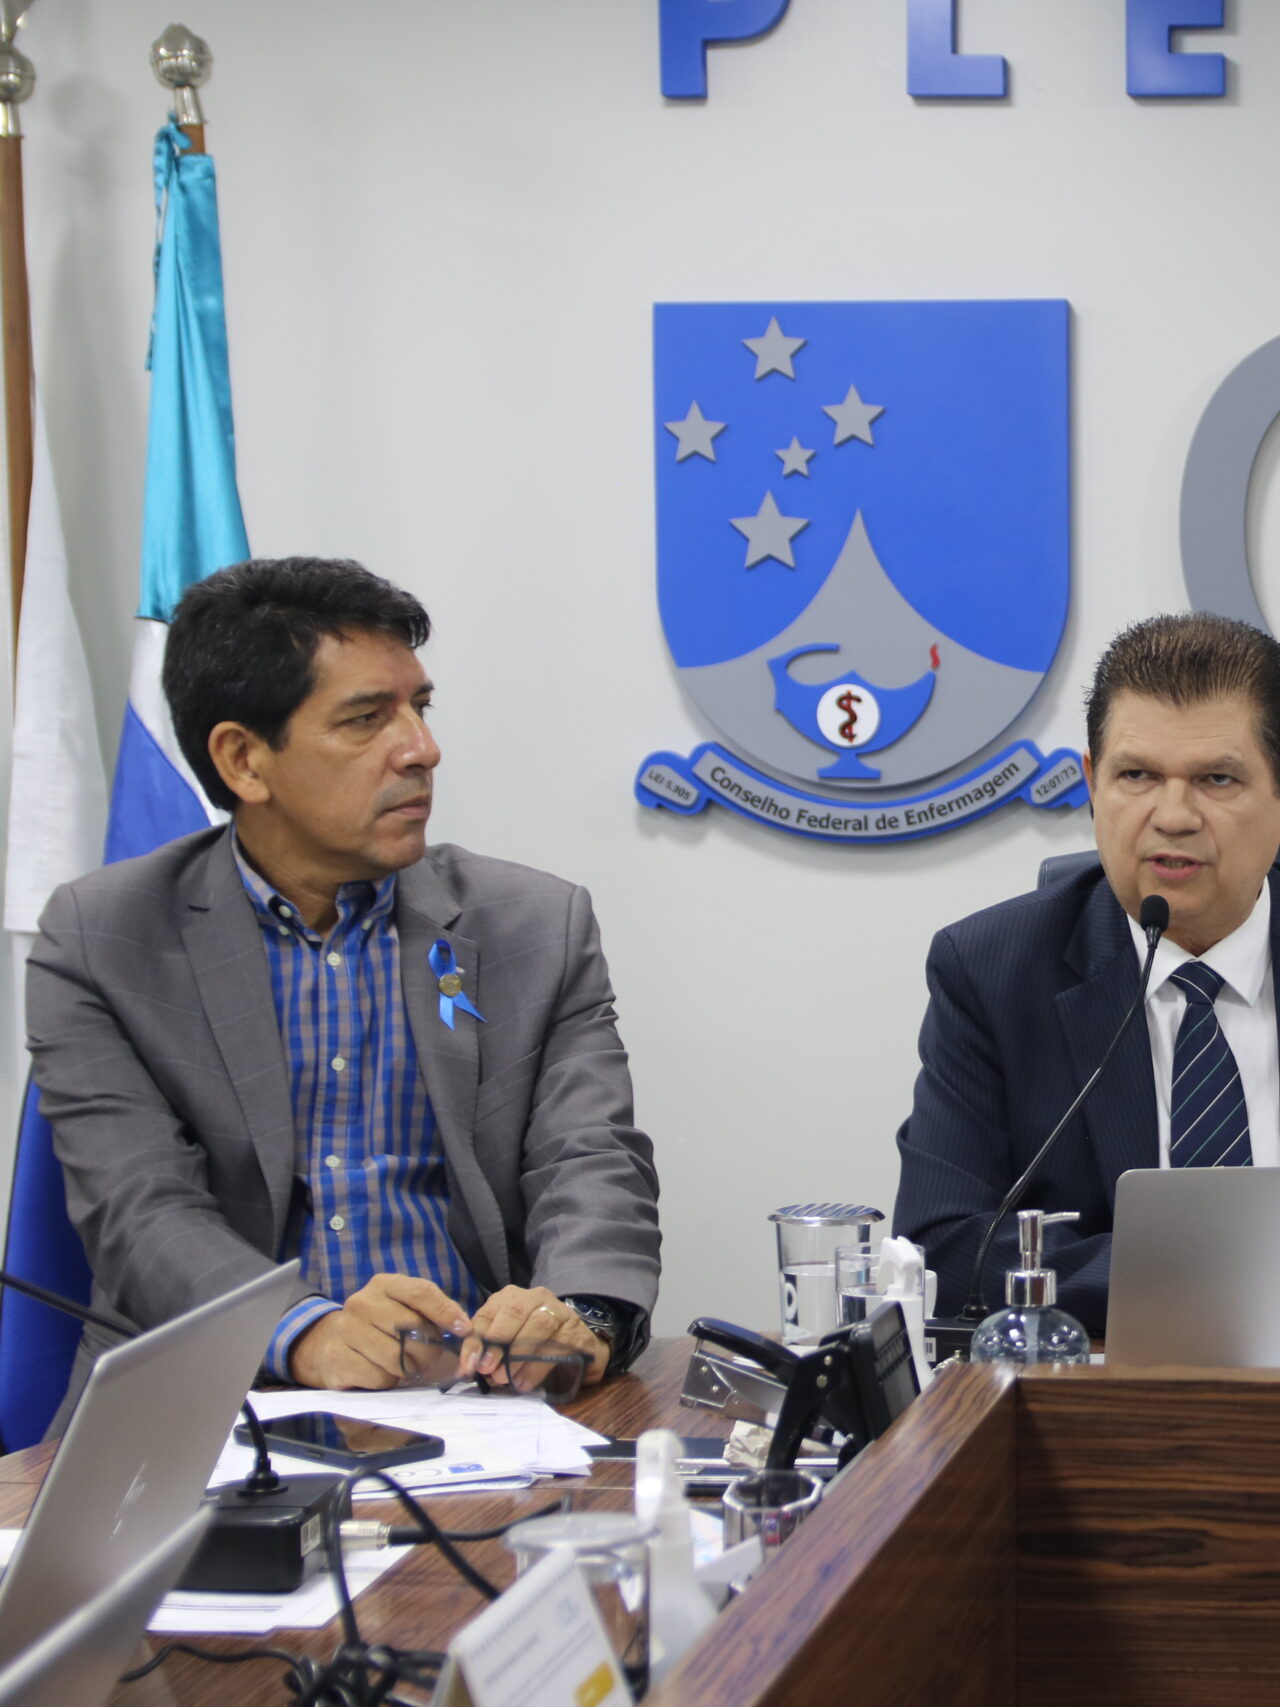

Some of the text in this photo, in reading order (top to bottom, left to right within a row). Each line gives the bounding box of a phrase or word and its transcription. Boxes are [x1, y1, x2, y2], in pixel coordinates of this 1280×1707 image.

[648, 770, 691, 800] LEI 5.905
[710, 762, 1020, 831] Conselho Federal de Enfermagem
